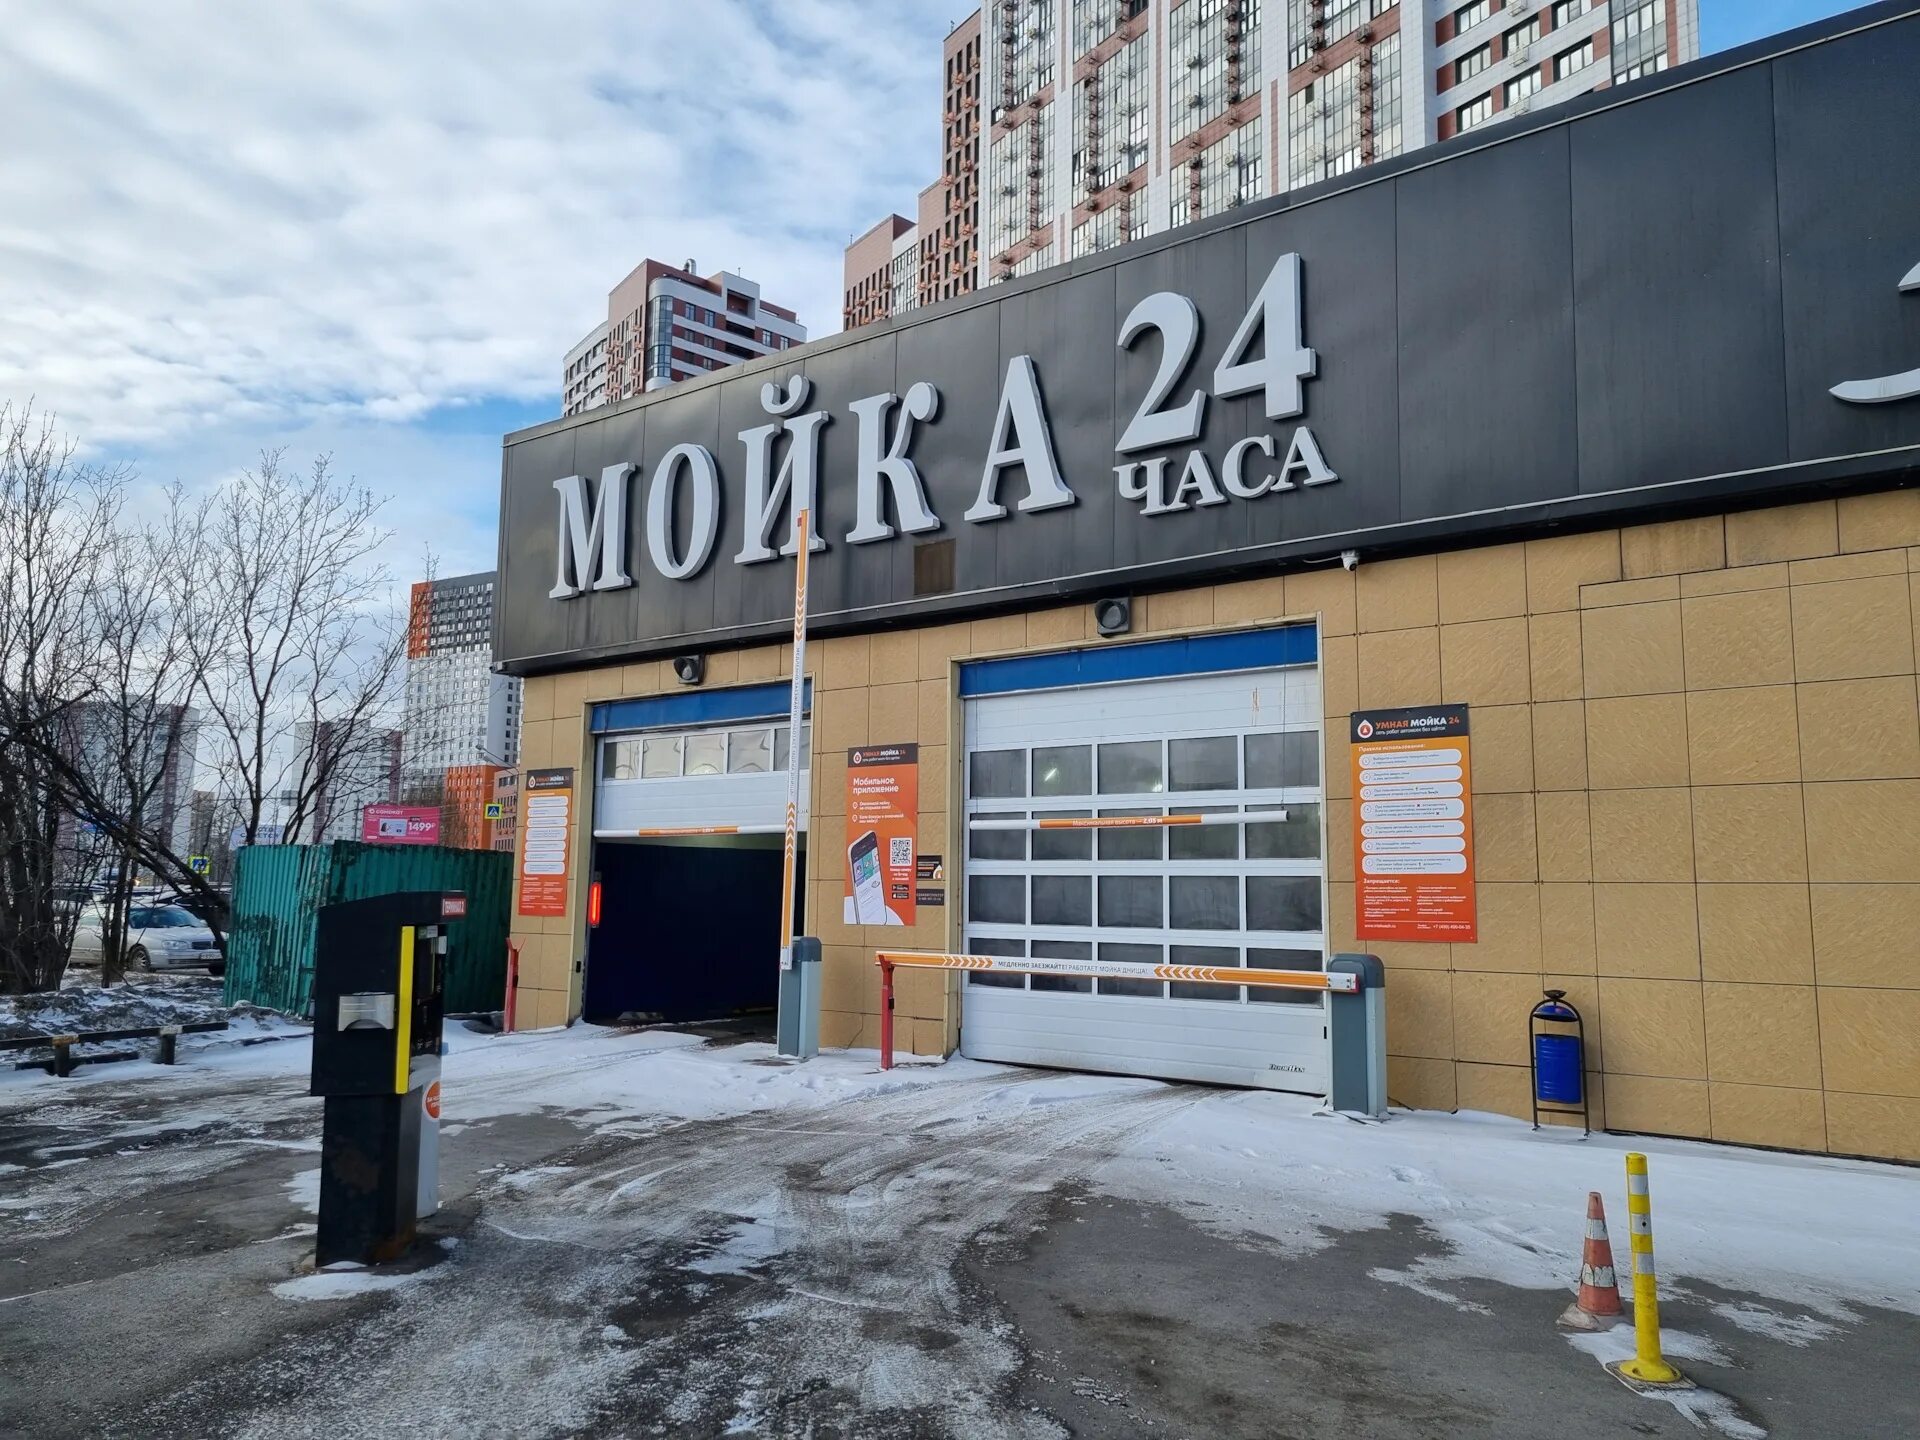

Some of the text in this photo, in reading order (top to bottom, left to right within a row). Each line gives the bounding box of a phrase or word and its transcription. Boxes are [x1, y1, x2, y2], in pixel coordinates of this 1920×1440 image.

[548, 252, 1319, 601] МОЙКА 24
[1112, 425, 1339, 517] ЧАСА
[1375, 715, 1460, 730] УМНАЯ МОЙКА 24
[853, 777, 895, 786] Мобильное
[853, 785, 899, 796] приложение
[1068, 964, 1098, 972] РАБОТАЕТ
[1099, 965, 1121, 973] МОЙКА
